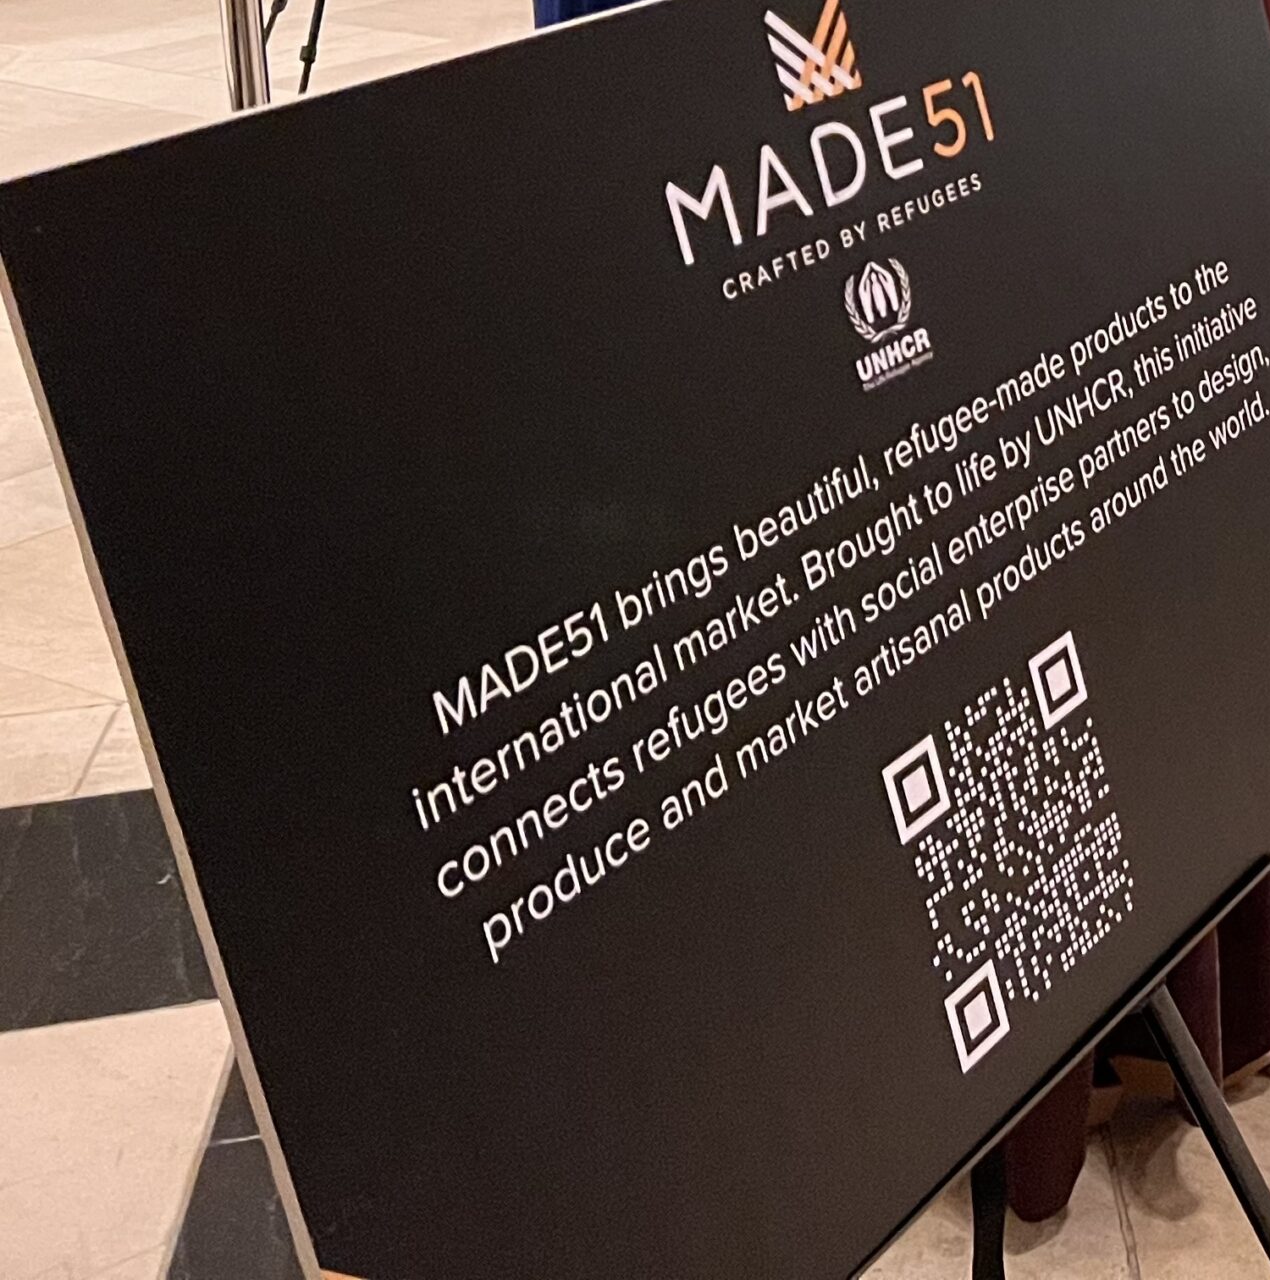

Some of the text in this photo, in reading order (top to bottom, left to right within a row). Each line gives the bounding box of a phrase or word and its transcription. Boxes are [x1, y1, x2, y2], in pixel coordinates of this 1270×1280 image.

[665, 71, 994, 265] MADE51
[722, 172, 983, 300] CRAFTED BY REFUGEES
[855, 327, 932, 382] UNHCR
[413, 298, 1256, 829] international market. Brought to life by UNHCR, this initiative
[433, 603, 608, 733] MADE51
[616, 546, 728, 629] brings
[734, 455, 878, 561] beautiful,
[884, 353, 1065, 475] refugee-made
[1070, 296, 1167, 375] products
[1170, 282, 1192, 309] to
[1195, 262, 1228, 295] the
[438, 346, 1269, 897] connects refugees with social enterprise partners to design,
[483, 391, 1269, 963] produce and market artisanal products around the world.
